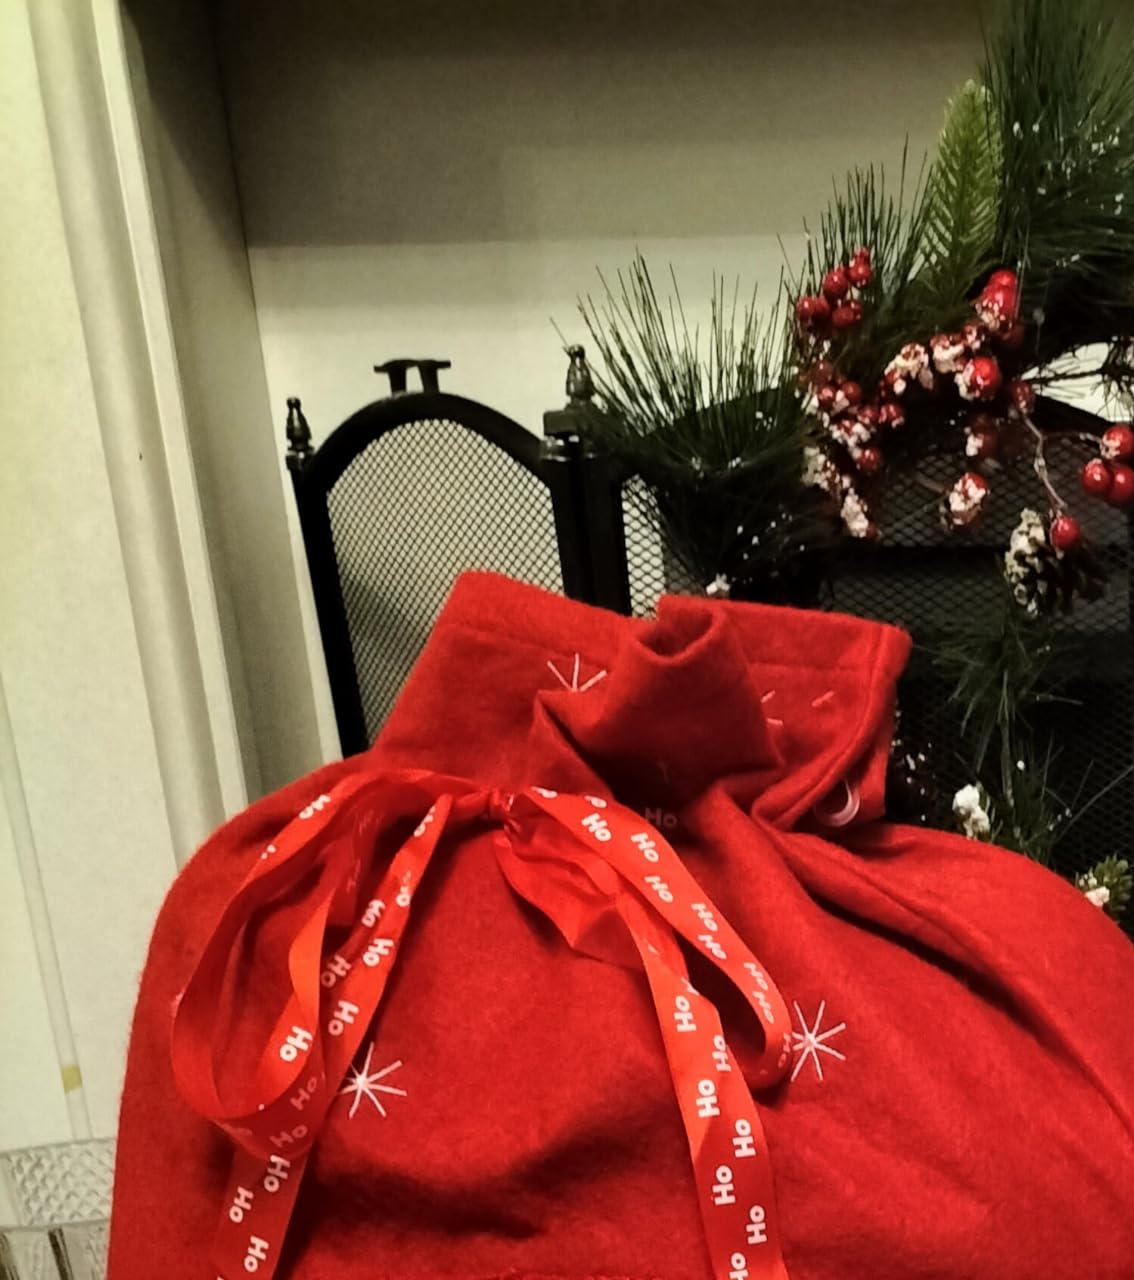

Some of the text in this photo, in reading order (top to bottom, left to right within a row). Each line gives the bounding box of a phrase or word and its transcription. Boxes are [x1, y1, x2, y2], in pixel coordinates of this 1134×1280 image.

[582, 814, 611, 841] Ho
[645, 876, 673, 902] Ho
[631, 833, 658, 862] Ho
[692, 904, 717, 931] Ho
[330, 939, 393, 1034] Ho Ho
[674, 996, 696, 1031] Ho
[280, 1027, 312, 1061] Ho
[712, 1035, 731, 1071] Ho
[696, 1080, 719, 1117] Ho
[733, 1120, 755, 1157] Ho
[264, 1155, 289, 1192] Ho
[713, 1166, 735, 1205] Ho
[230, 1187, 253, 1222] Ho
[747, 1206, 766, 1244] Ho
[245, 1236, 268, 1272] Ho
